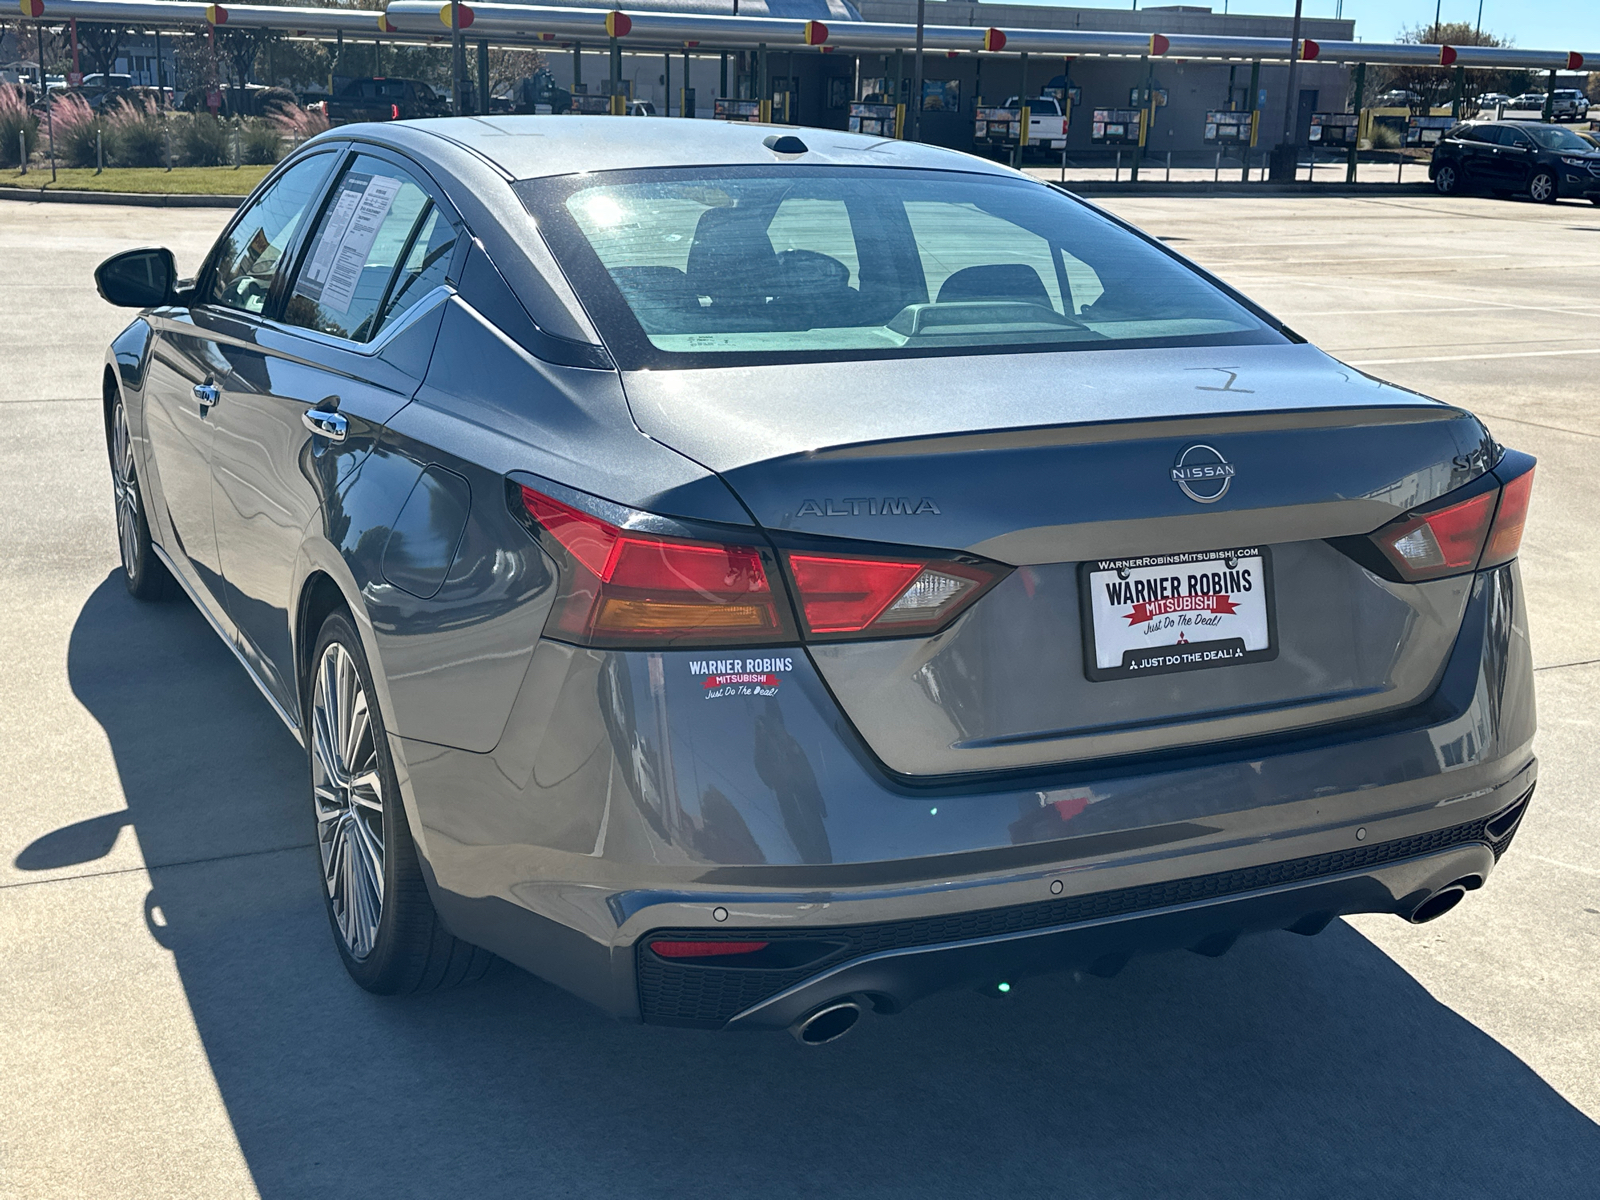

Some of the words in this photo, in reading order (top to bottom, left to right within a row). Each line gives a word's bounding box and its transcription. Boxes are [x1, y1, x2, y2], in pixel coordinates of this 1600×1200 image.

[1172, 465, 1234, 479] NISSAN
[795, 496, 941, 517] ALTIMA
[1106, 576, 1181, 605] WARNER
[1187, 569, 1252, 594] ROBINS
[1146, 597, 1216, 615] MITSUBISHI
[1144, 621, 1163, 635] Just
[1164, 617, 1175, 627] Do
[1177, 614, 1192, 627] The
[1194, 615, 1222, 627] Deal!
[689, 660, 742, 674] WARNER
[746, 658, 793, 673] ROBINS
[1139, 657, 1164, 668] JUST
[1166, 655, 1180, 665] DO
[1181, 652, 1202, 663] THE
[1204, 649, 1233, 661] DEAL!
[716, 675, 766, 684] MITSUBISHI
[705, 689, 723, 699] Just
[724, 686, 736, 696] Do
[737, 685, 752, 695] The
[754, 686, 778, 697] Deal!
